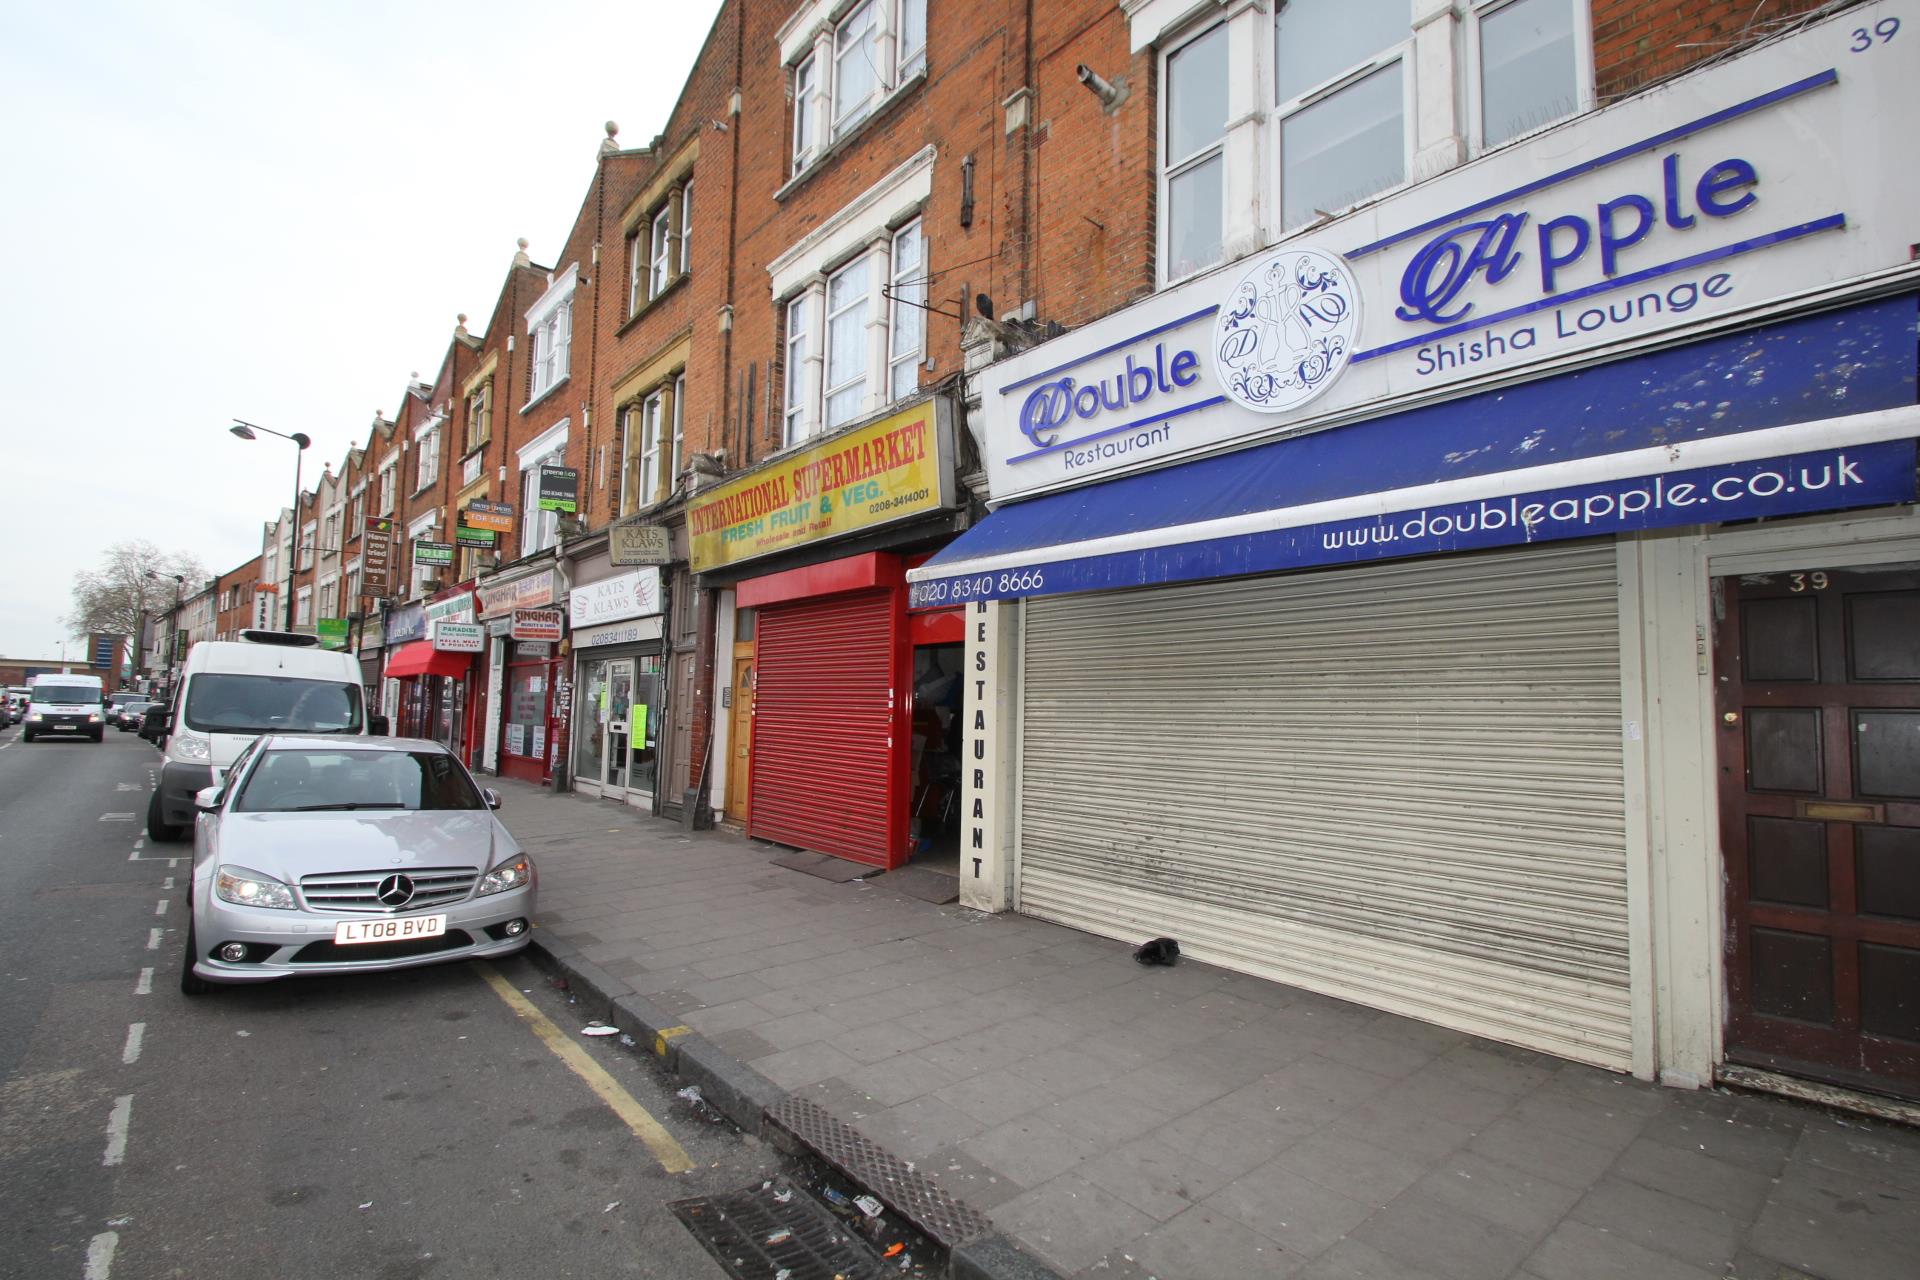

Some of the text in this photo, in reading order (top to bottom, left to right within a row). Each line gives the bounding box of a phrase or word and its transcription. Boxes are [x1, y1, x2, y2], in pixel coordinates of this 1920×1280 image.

[1850, 16, 1901, 53] 39
[1018, 151, 1759, 448] Double Apple
[1416, 273, 1734, 376] Shisha Lounge
[1063, 421, 1172, 470] Restaurant
[691, 420, 926, 537] INTERNATIONAL SUPERMARKET
[869, 487, 930, 515] 0208-3414001
[1322, 455, 1864, 550] www.doubleapple.co.uk
[721, 517, 764, 545] FRESH
[770, 502, 812, 530] FRUIT
[820, 496, 833, 513] &
[809, 517, 832, 532] Retail
[367, 533, 389, 542] Have
[622, 539, 664, 549] KLAWS
[625, 528, 658, 539] KATS
[419, 548, 451, 559] TO LET
[597, 580, 625, 598] KATS
[918, 569, 1044, 602] 020 8340 8666
[1789, 571, 1829, 593] 39
[593, 596, 629, 616] KLAWS
[515, 610, 560, 625] SINGHAR
[346, 918, 438, 940] LT08 BVD
